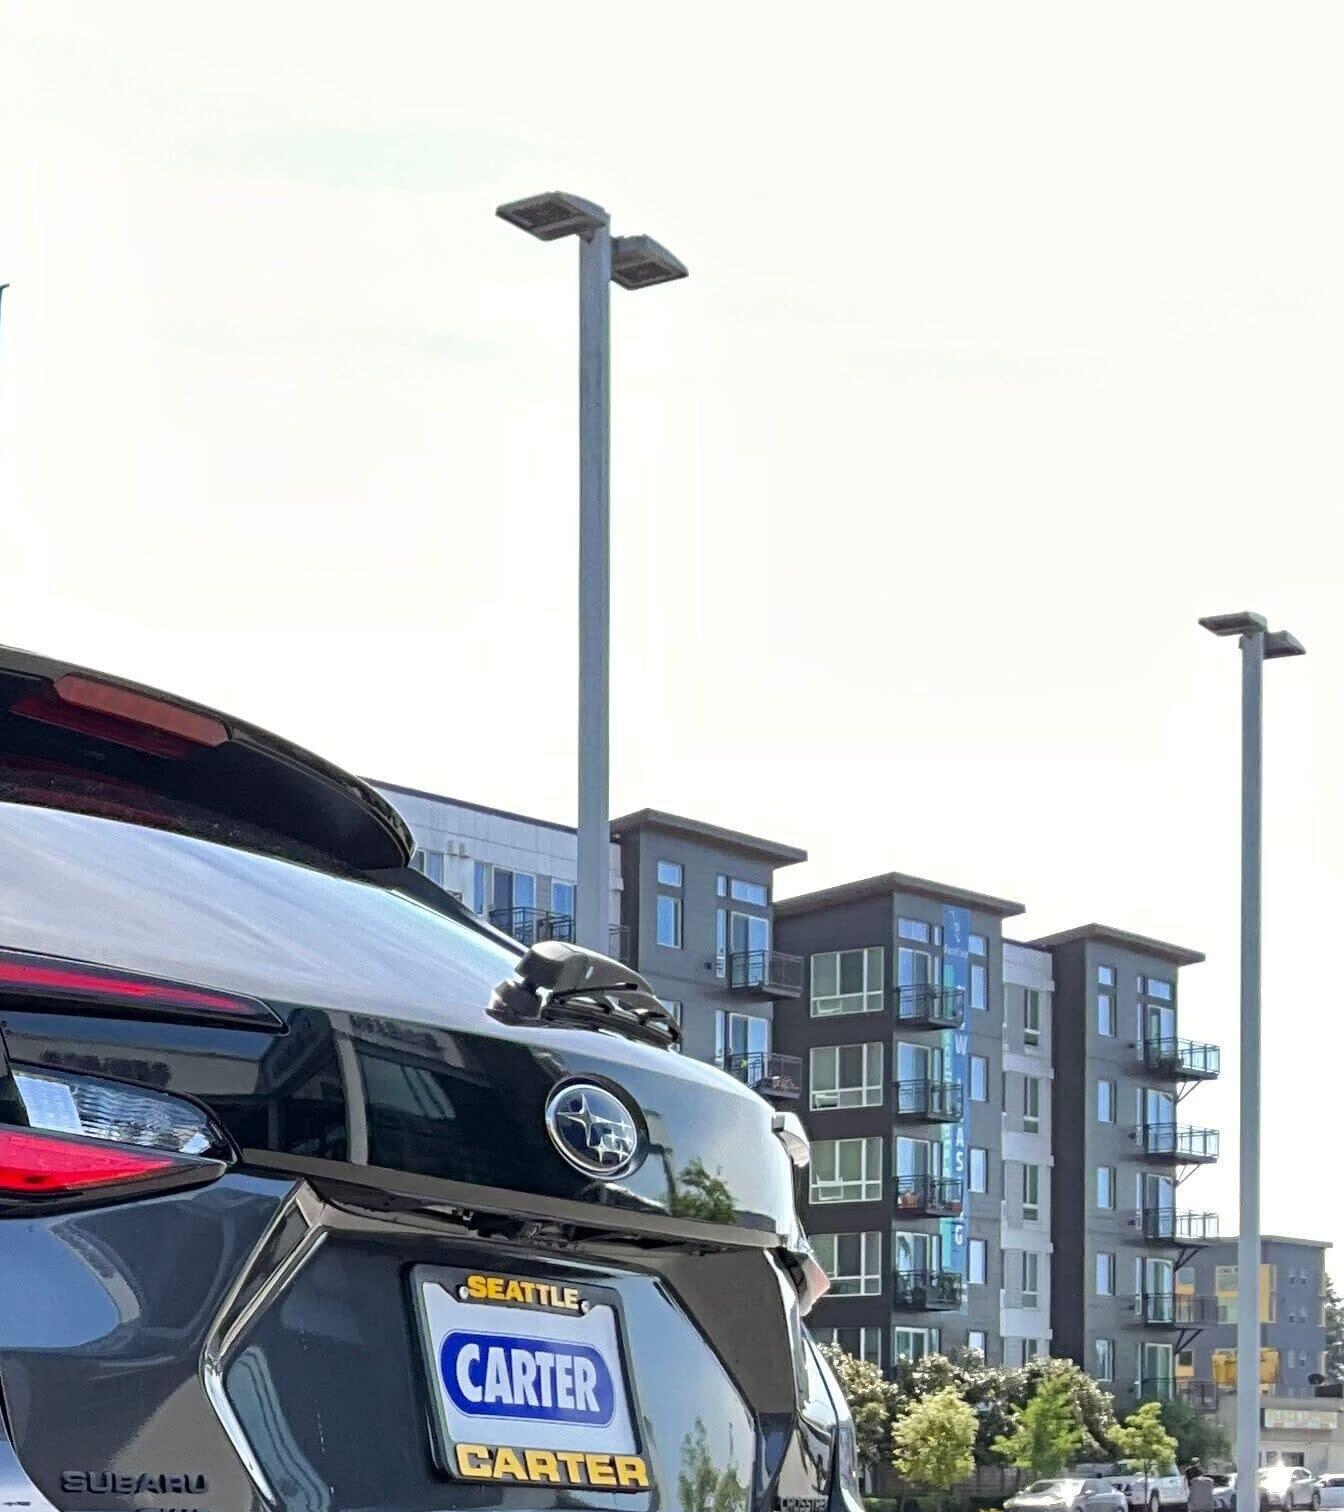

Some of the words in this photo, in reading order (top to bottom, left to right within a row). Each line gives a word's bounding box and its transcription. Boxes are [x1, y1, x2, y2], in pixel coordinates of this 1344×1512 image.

[467, 1274, 580, 1310] SEATTLE
[456, 1343, 600, 1412] CARTER
[61, 1470, 209, 1494] SUBARU
[456, 1444, 650, 1487] CARTER
